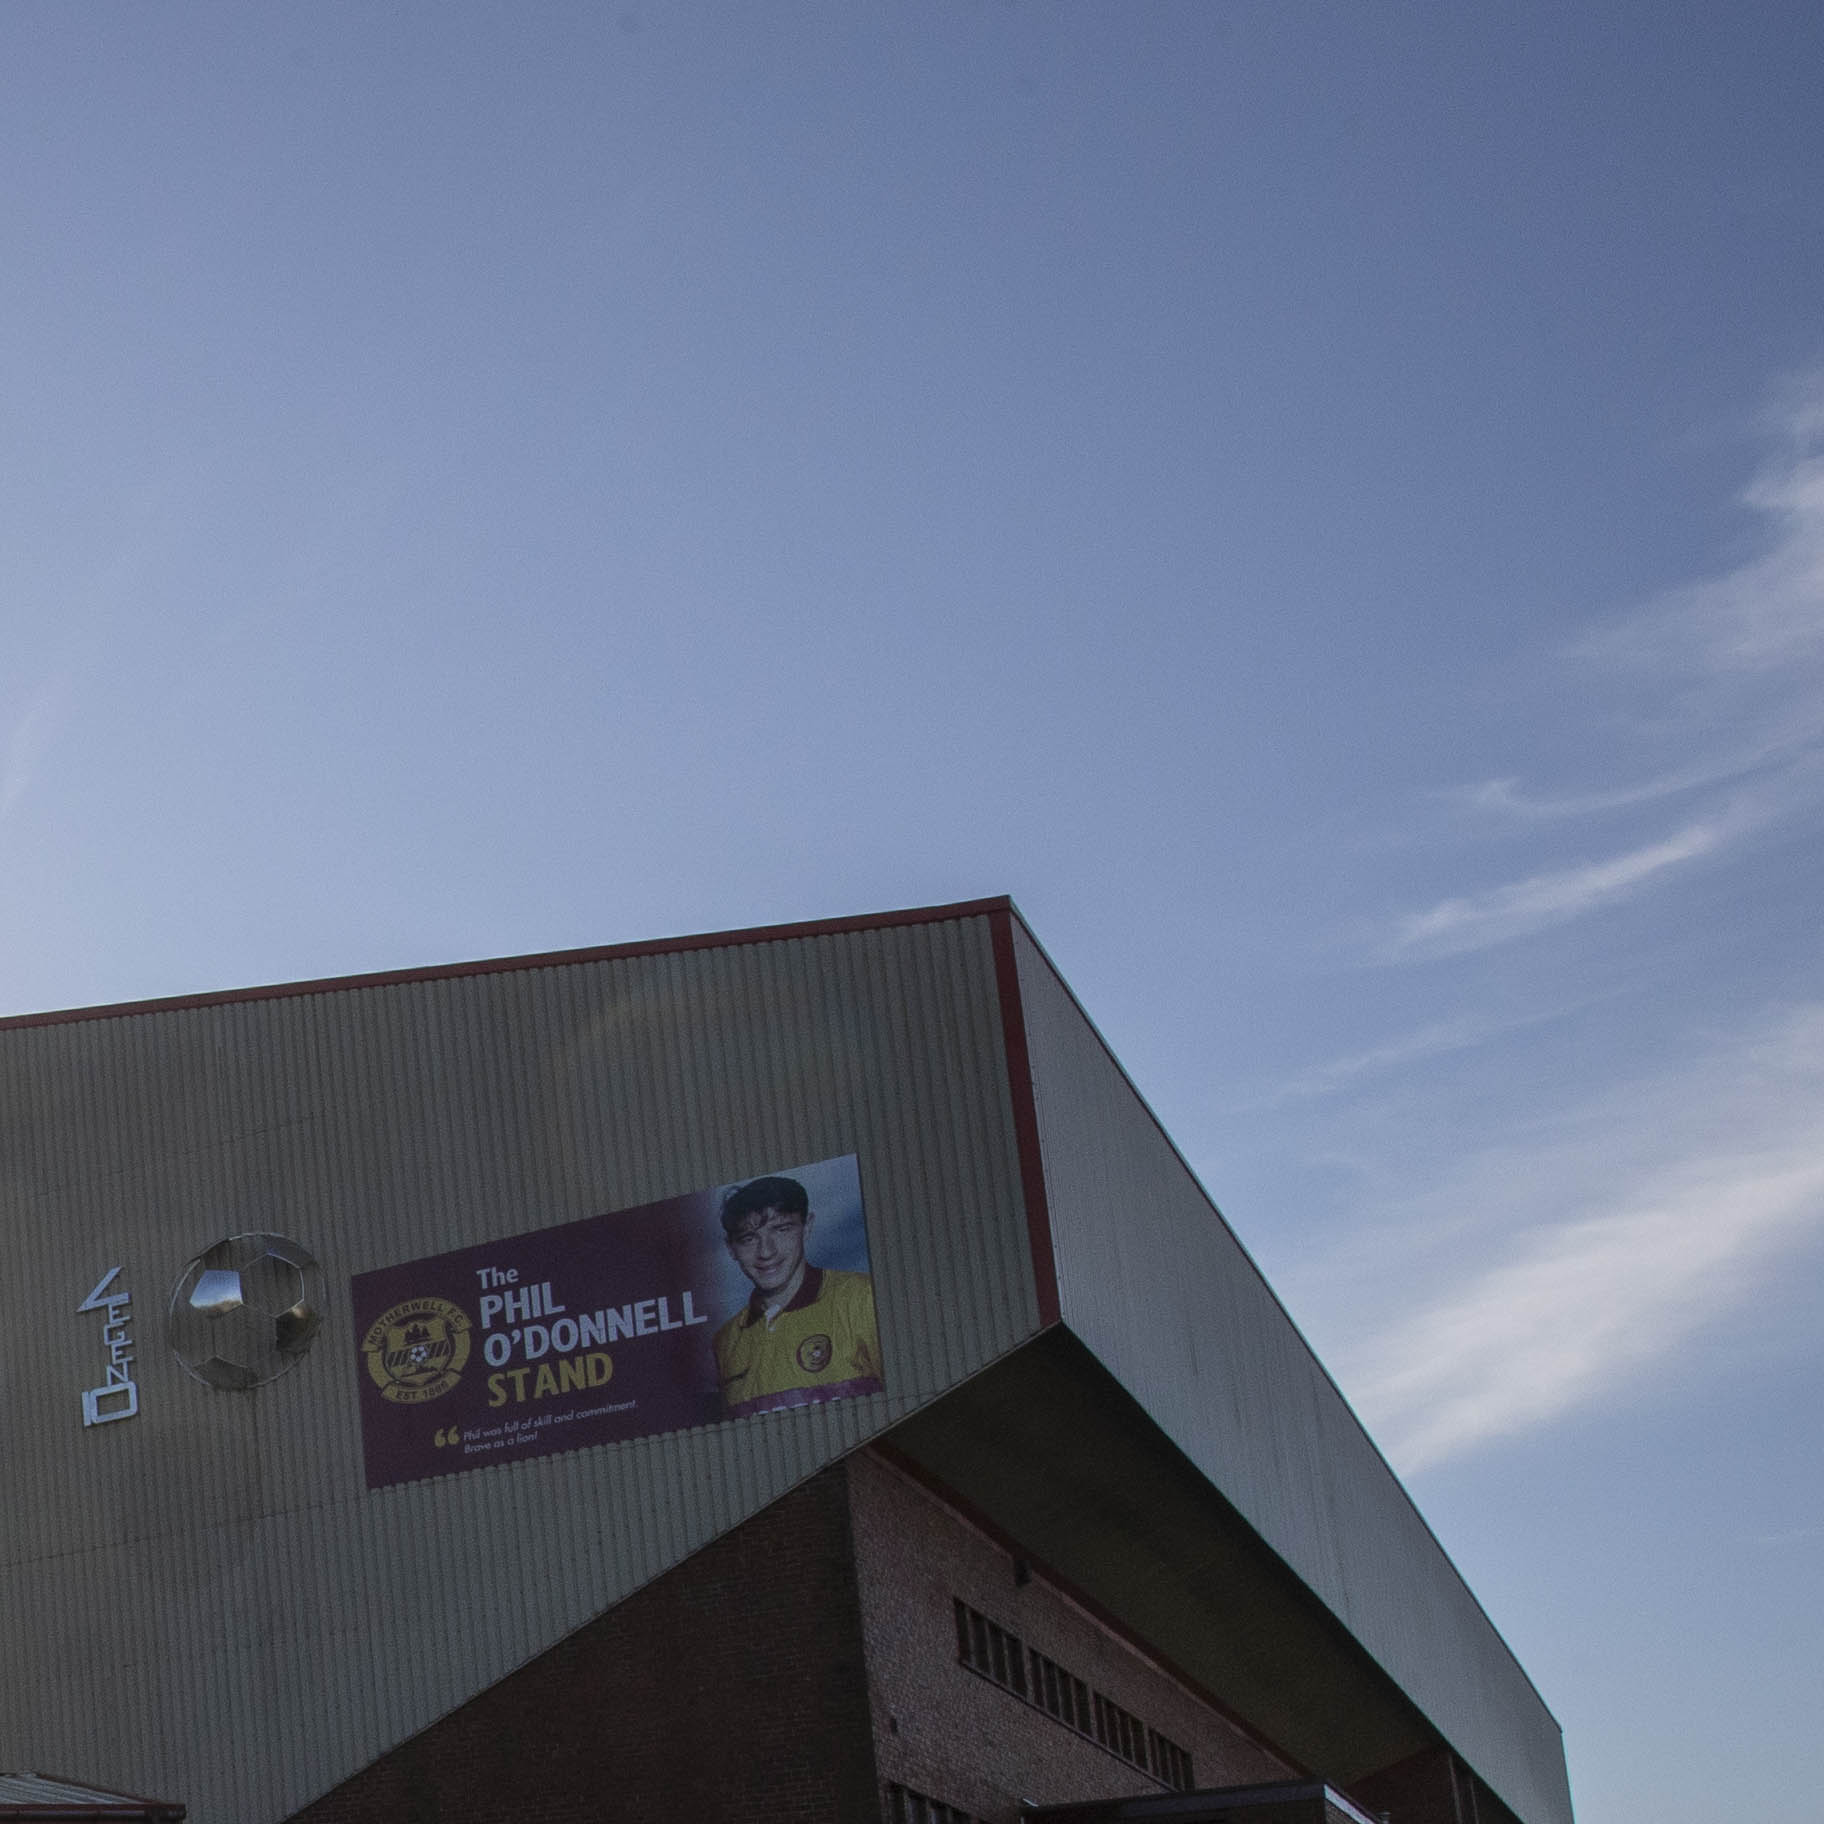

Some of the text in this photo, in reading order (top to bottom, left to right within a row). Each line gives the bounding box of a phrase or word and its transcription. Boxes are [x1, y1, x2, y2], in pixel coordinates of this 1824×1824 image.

[476, 1266, 520, 1289] The
[368, 1301, 443, 1345] MOTHERWELL
[479, 1281, 566, 1330] PHIL
[483, 1291, 708, 1367] O'DONNELL
[487, 1352, 614, 1408] STAND
[463, 1429, 481, 1442] Phil
[483, 1427, 502, 1438] was
[504, 1420, 519, 1434] full
[520, 1418, 532, 1430] of
[533, 1414, 552, 1428] skill
[554, 1410, 574, 1424] and
[464, 1441, 492, 1454] Brave
[493, 1439, 505, 1449] as
